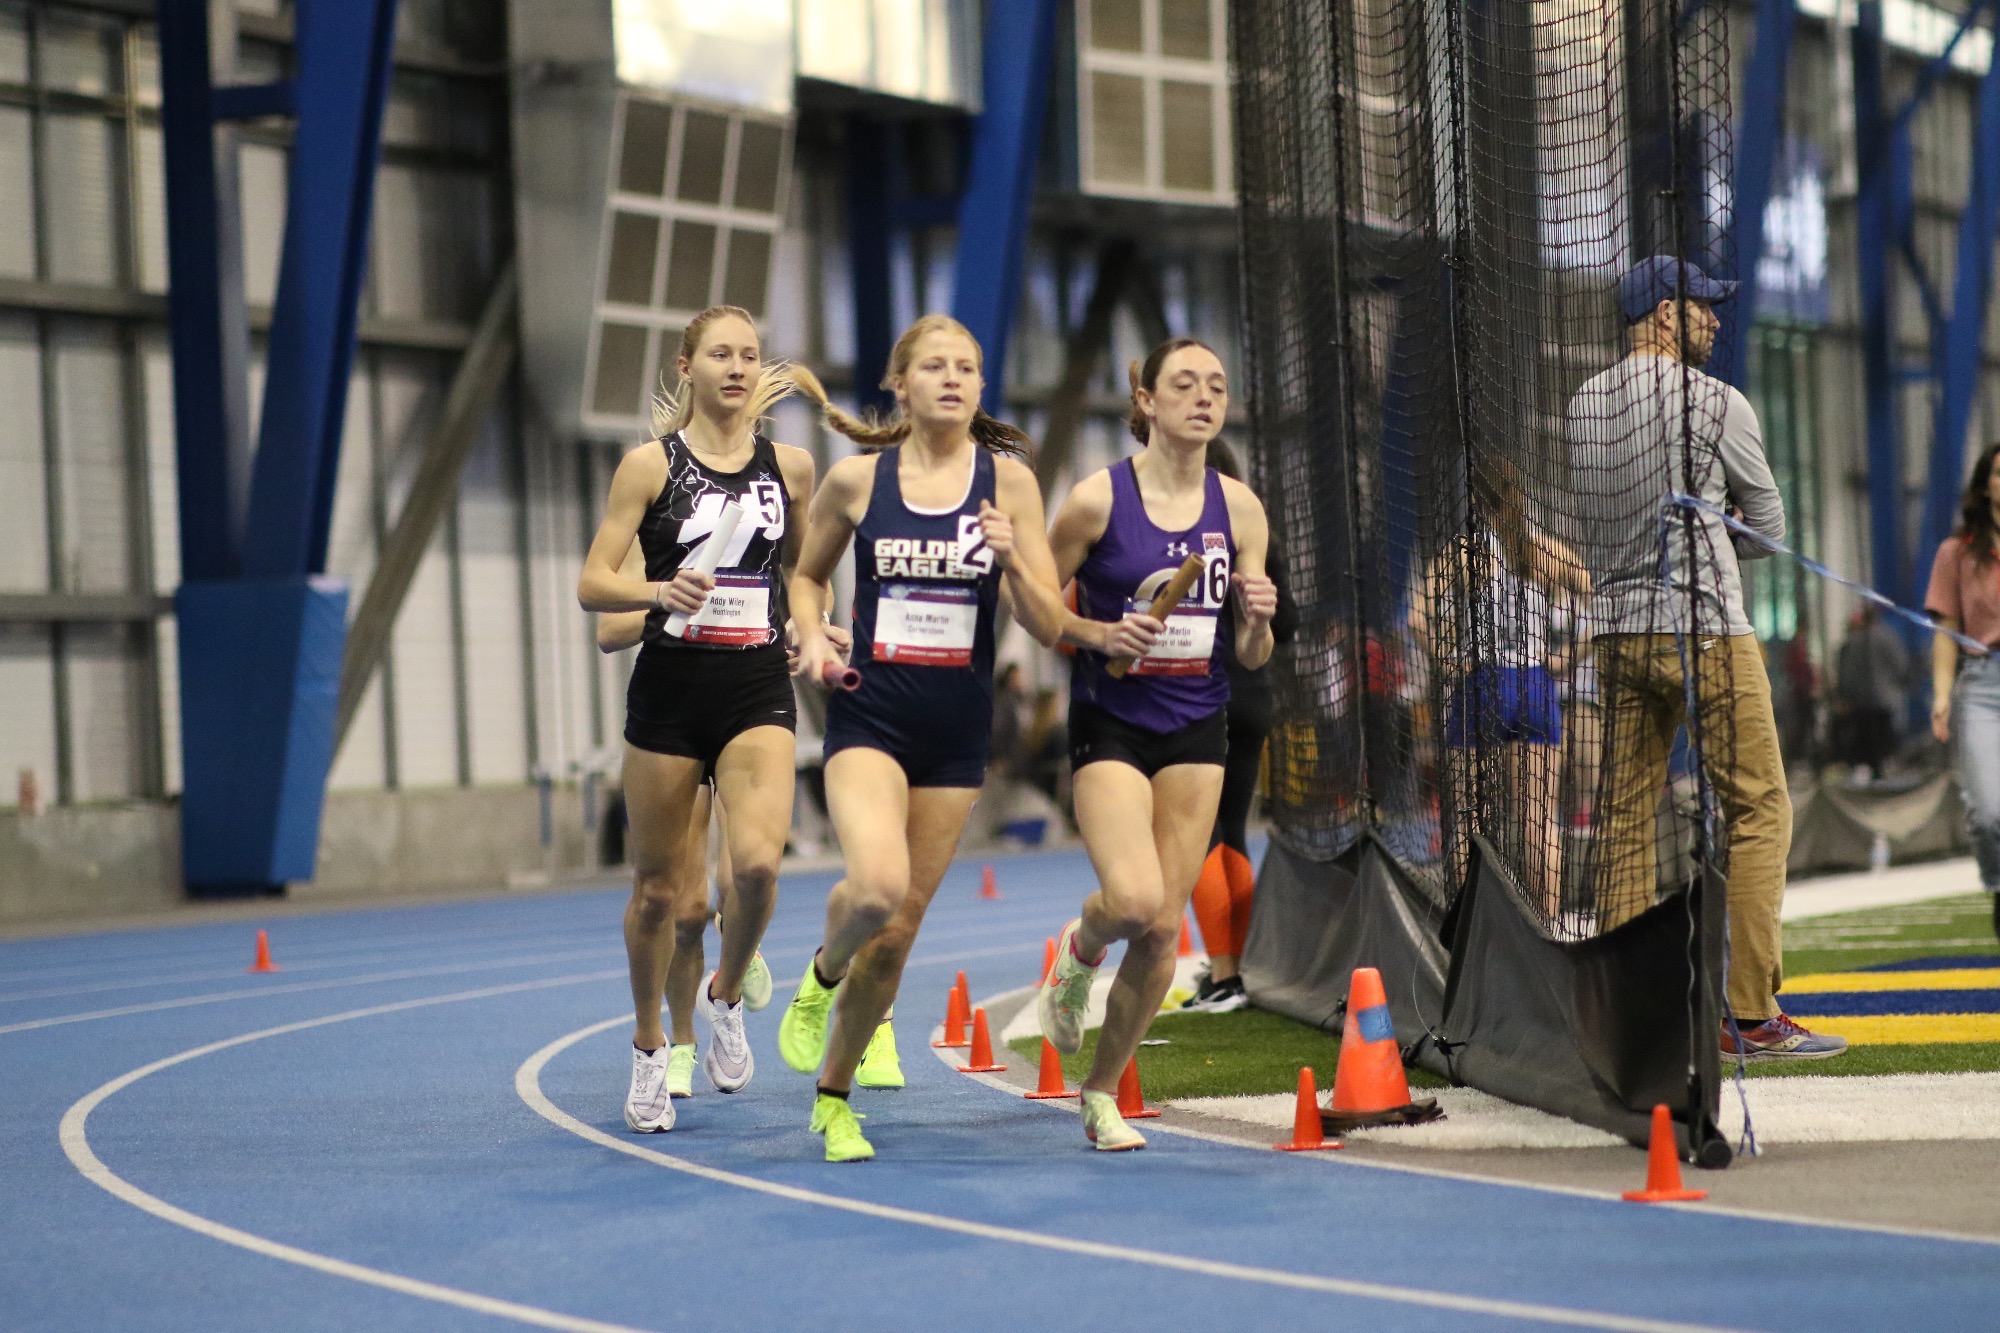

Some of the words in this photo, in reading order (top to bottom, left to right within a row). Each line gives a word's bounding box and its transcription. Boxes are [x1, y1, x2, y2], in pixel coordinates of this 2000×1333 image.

[756, 484, 781, 525] 5
[874, 538, 959, 560] GOLDE
[963, 521, 987, 569] 2
[1209, 557, 1227, 604] 6
[709, 596, 727, 606] Addy
[728, 597, 745, 607] Wiley
[712, 608, 741, 617] Huntington
